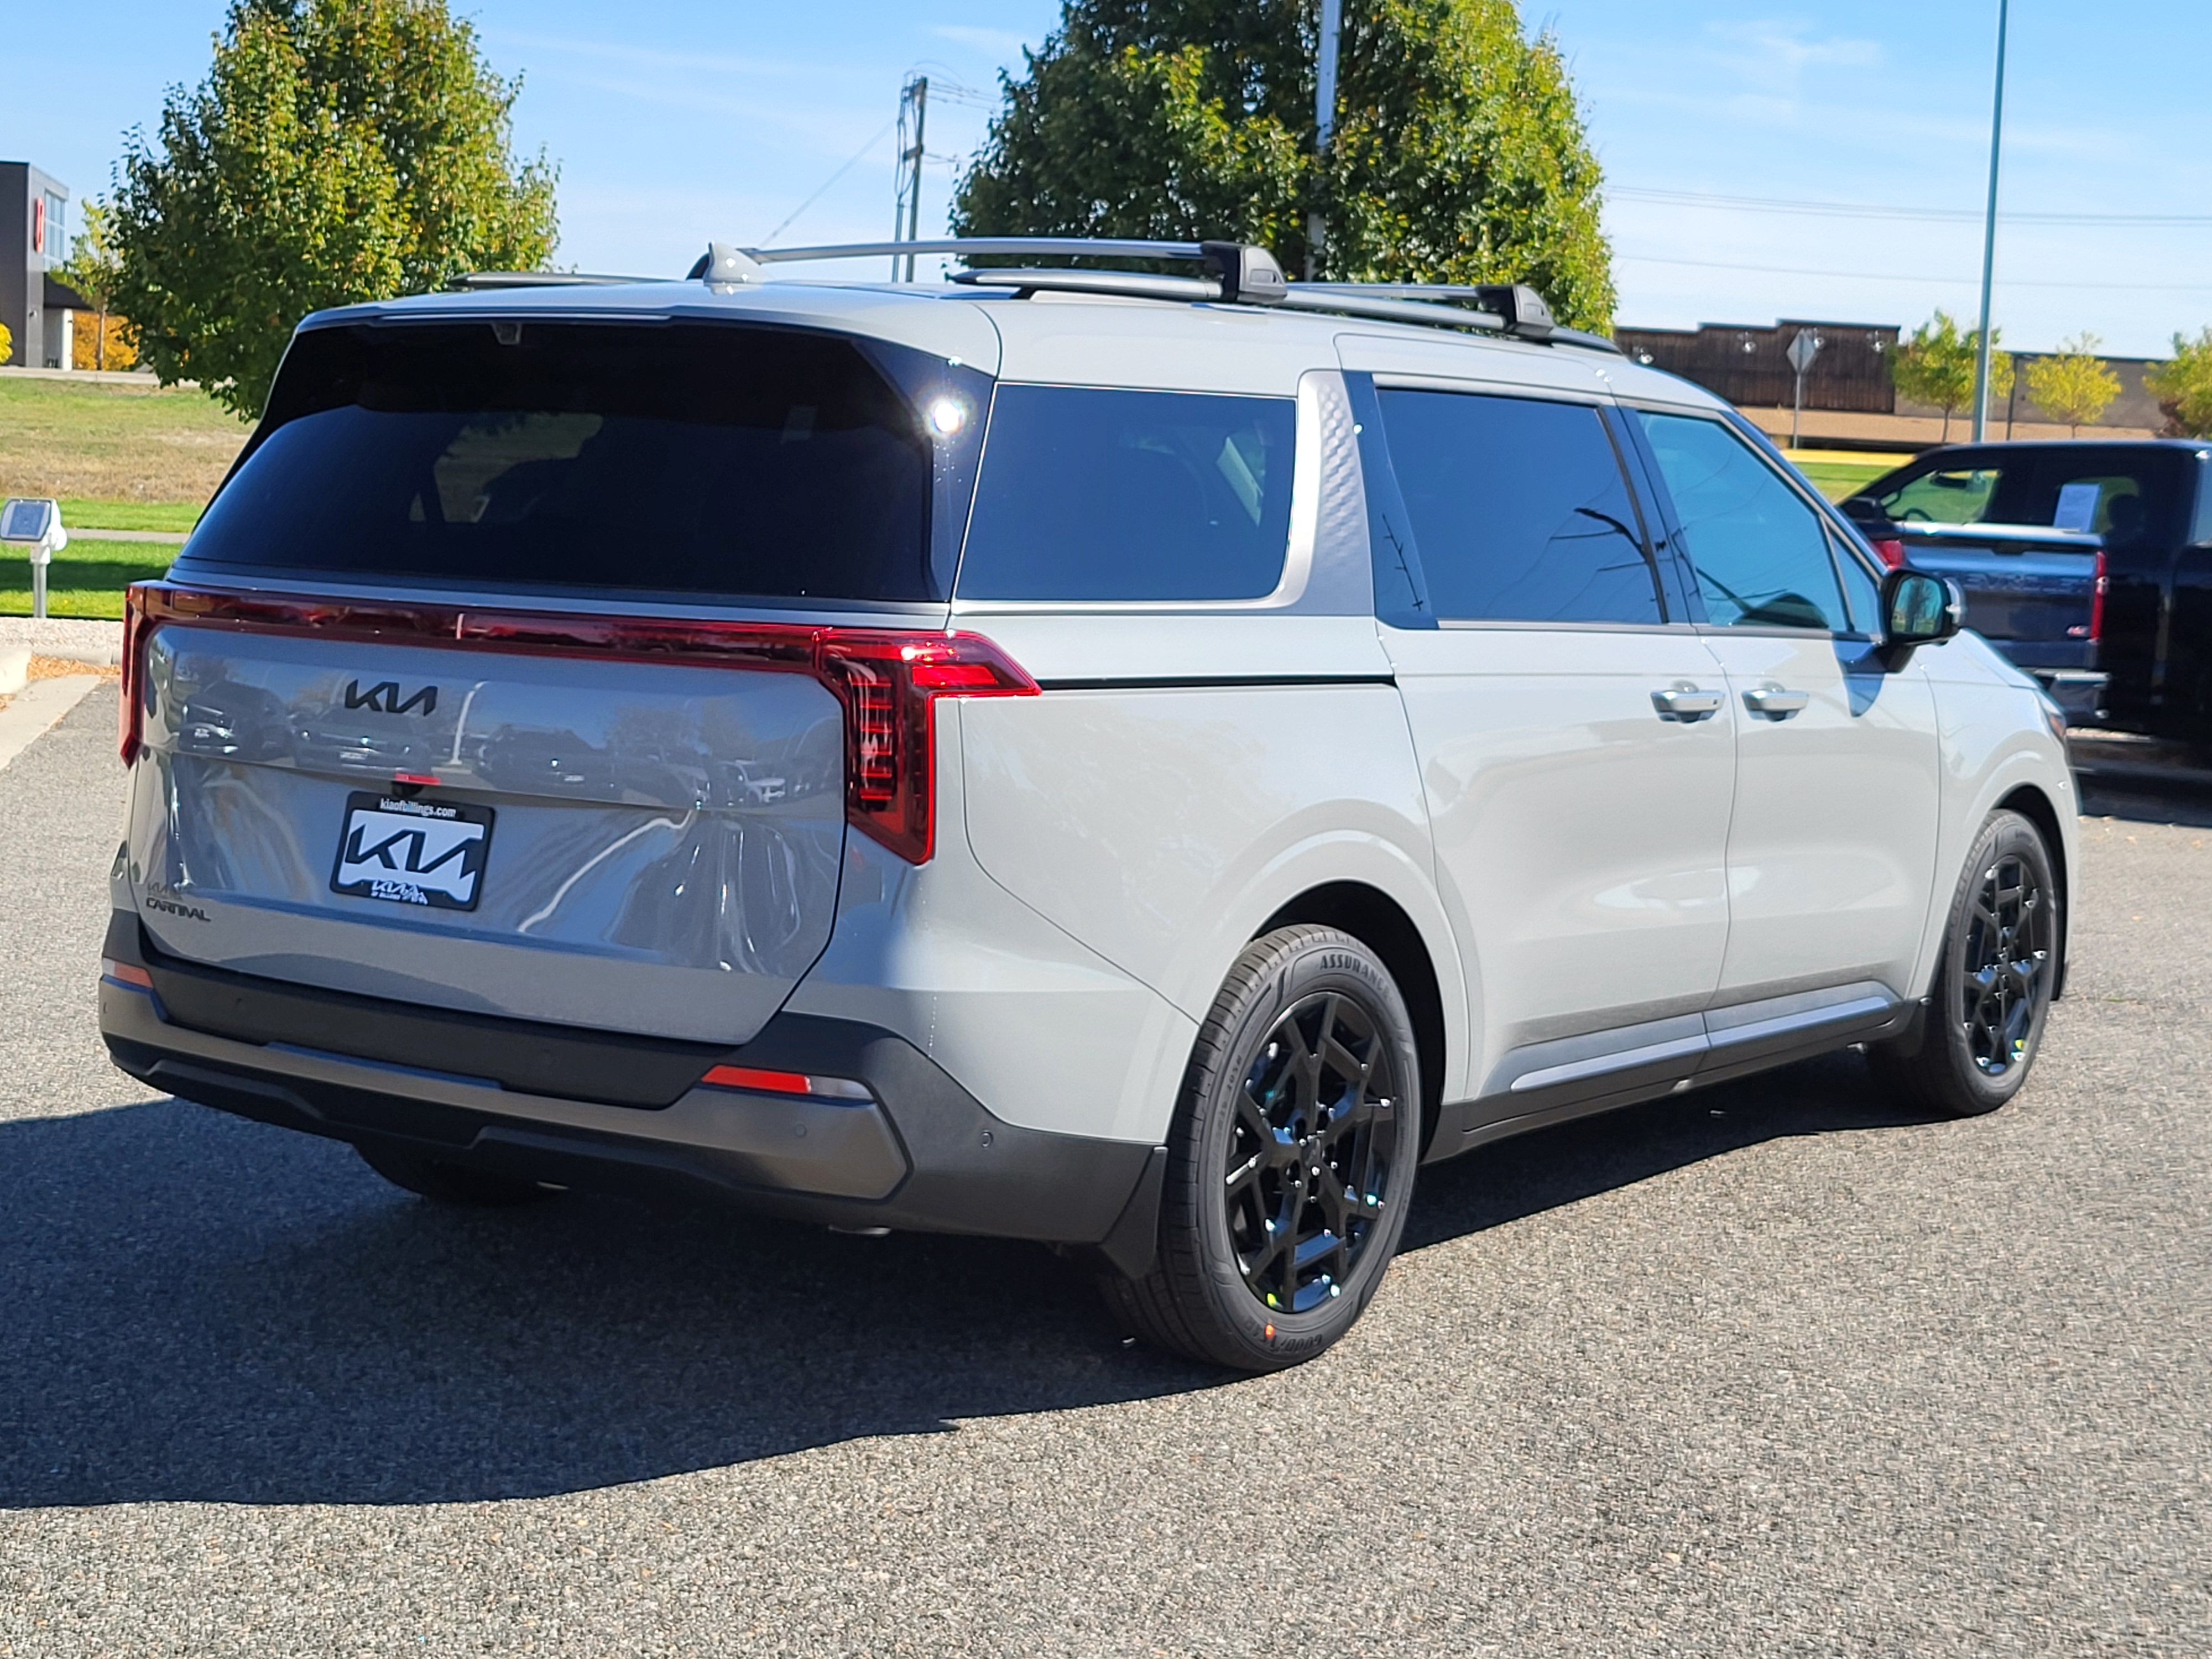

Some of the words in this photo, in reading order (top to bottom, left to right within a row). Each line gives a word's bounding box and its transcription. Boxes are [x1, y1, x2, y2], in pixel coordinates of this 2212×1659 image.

[345, 679, 439, 717] KIA
[345, 823, 480, 880] KIA
[372, 879, 407, 895] KIA
[145, 896, 212, 922] CARNIVAL
